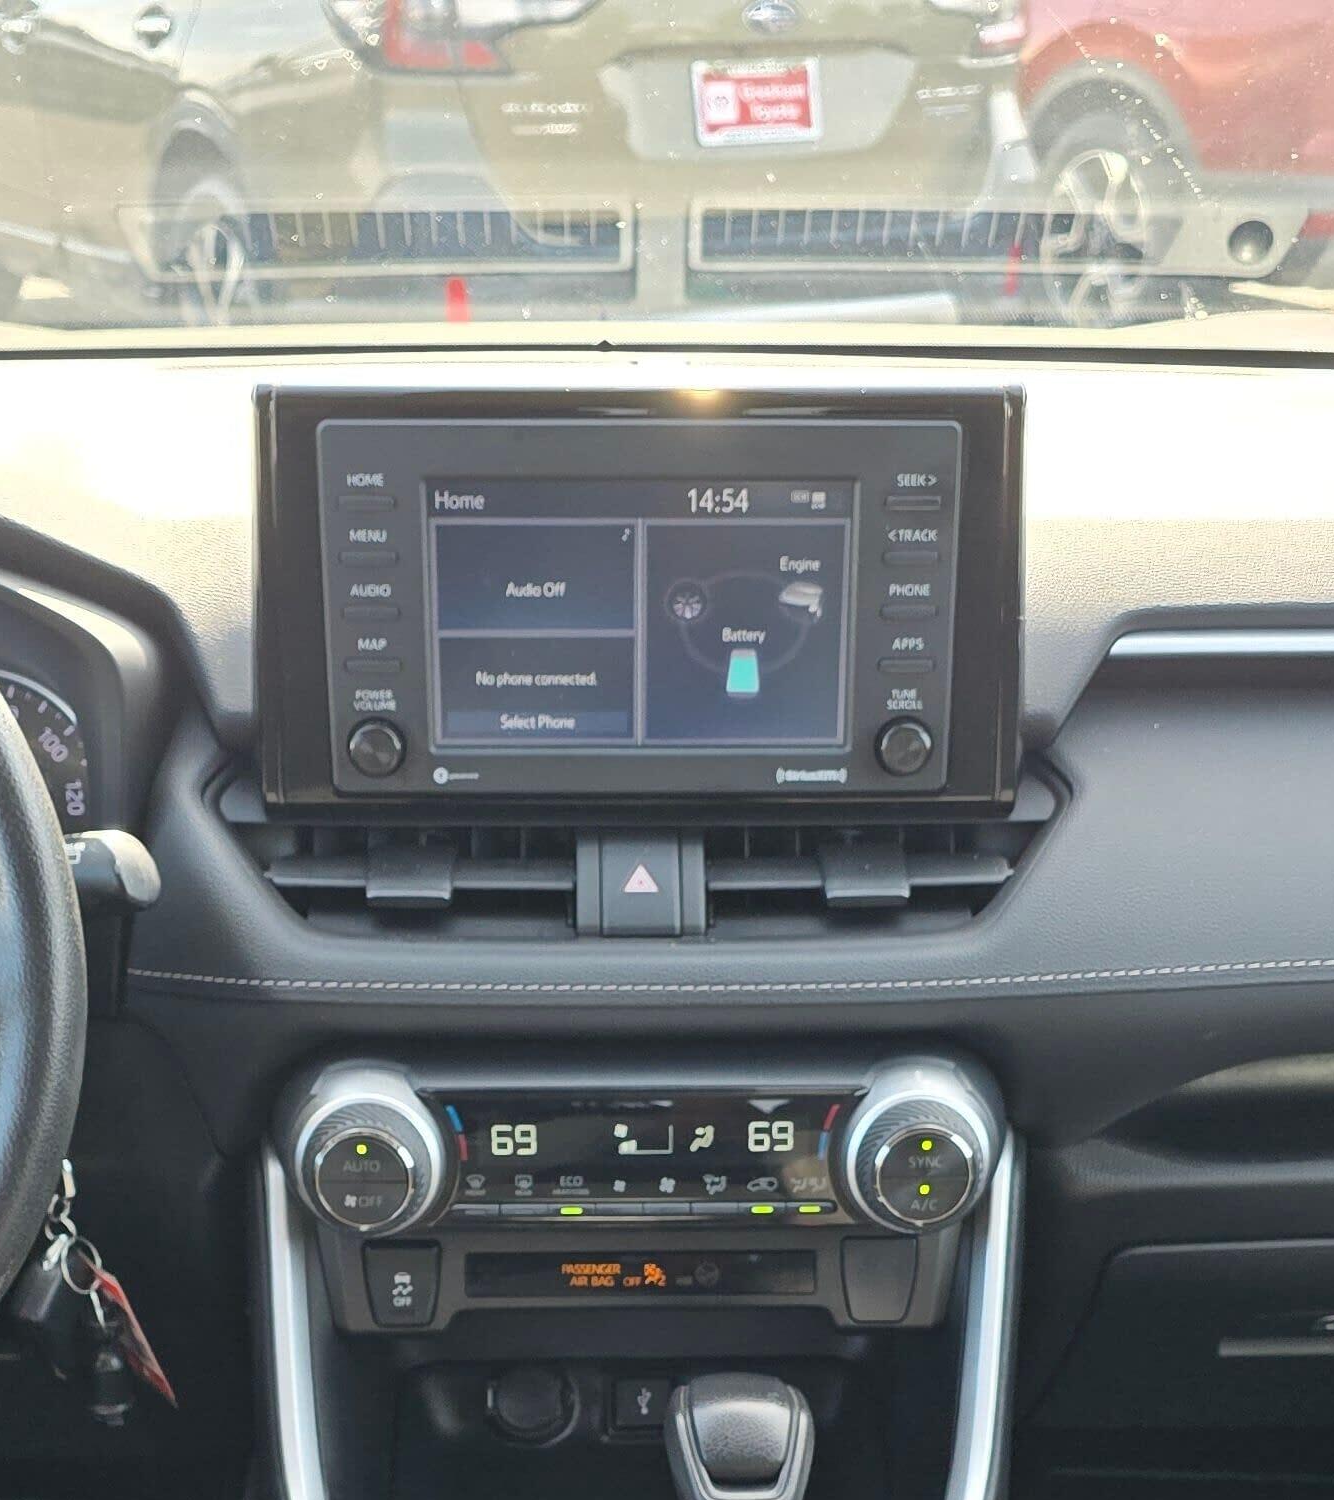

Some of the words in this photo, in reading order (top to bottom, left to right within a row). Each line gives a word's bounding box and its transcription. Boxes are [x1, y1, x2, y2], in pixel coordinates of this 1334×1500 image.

[346, 473, 384, 488] HOME
[434, 489, 485, 510] Home
[687, 488, 750, 513] 14:54
[349, 529, 388, 543] MENU
[779, 556, 821, 574] Engine
[350, 583, 392, 598] AUDIO
[505, 581, 542, 598] Audio
[543, 581, 567, 598] Off
[889, 583, 931, 597] PHONE
[722, 627, 766, 644] Battery
[357, 637, 388, 651] MAP
[892, 637, 925, 650] APPS
[475, 670, 495, 686] No
[496, 671, 534, 687] phone
[355, 689, 393, 700] POWER
[891, 688, 918, 700] TUNE
[353, 700, 396, 712] VOLUME
[500, 713, 536, 730] Select
[537, 713, 576, 730] Phone
[38, 726, 68, 763] 100
[65, 778, 86, 817] 120
[490, 1124, 538, 1156] 69
[747, 1120, 795, 1152] 69
[342, 1159, 381, 1173] AUTO
[908, 1156, 942, 1169] SYNC
[559, 1175, 584, 1188] ECO
[358, 1194, 383, 1208] OFF
[910, 1199, 938, 1211] A/C
[561, 1263, 622, 1275] PASSENGER
[569, 1276, 589, 1287] AIR
[591, 1276, 616, 1287] BAG
[622, 1276, 643, 1287] OFF
